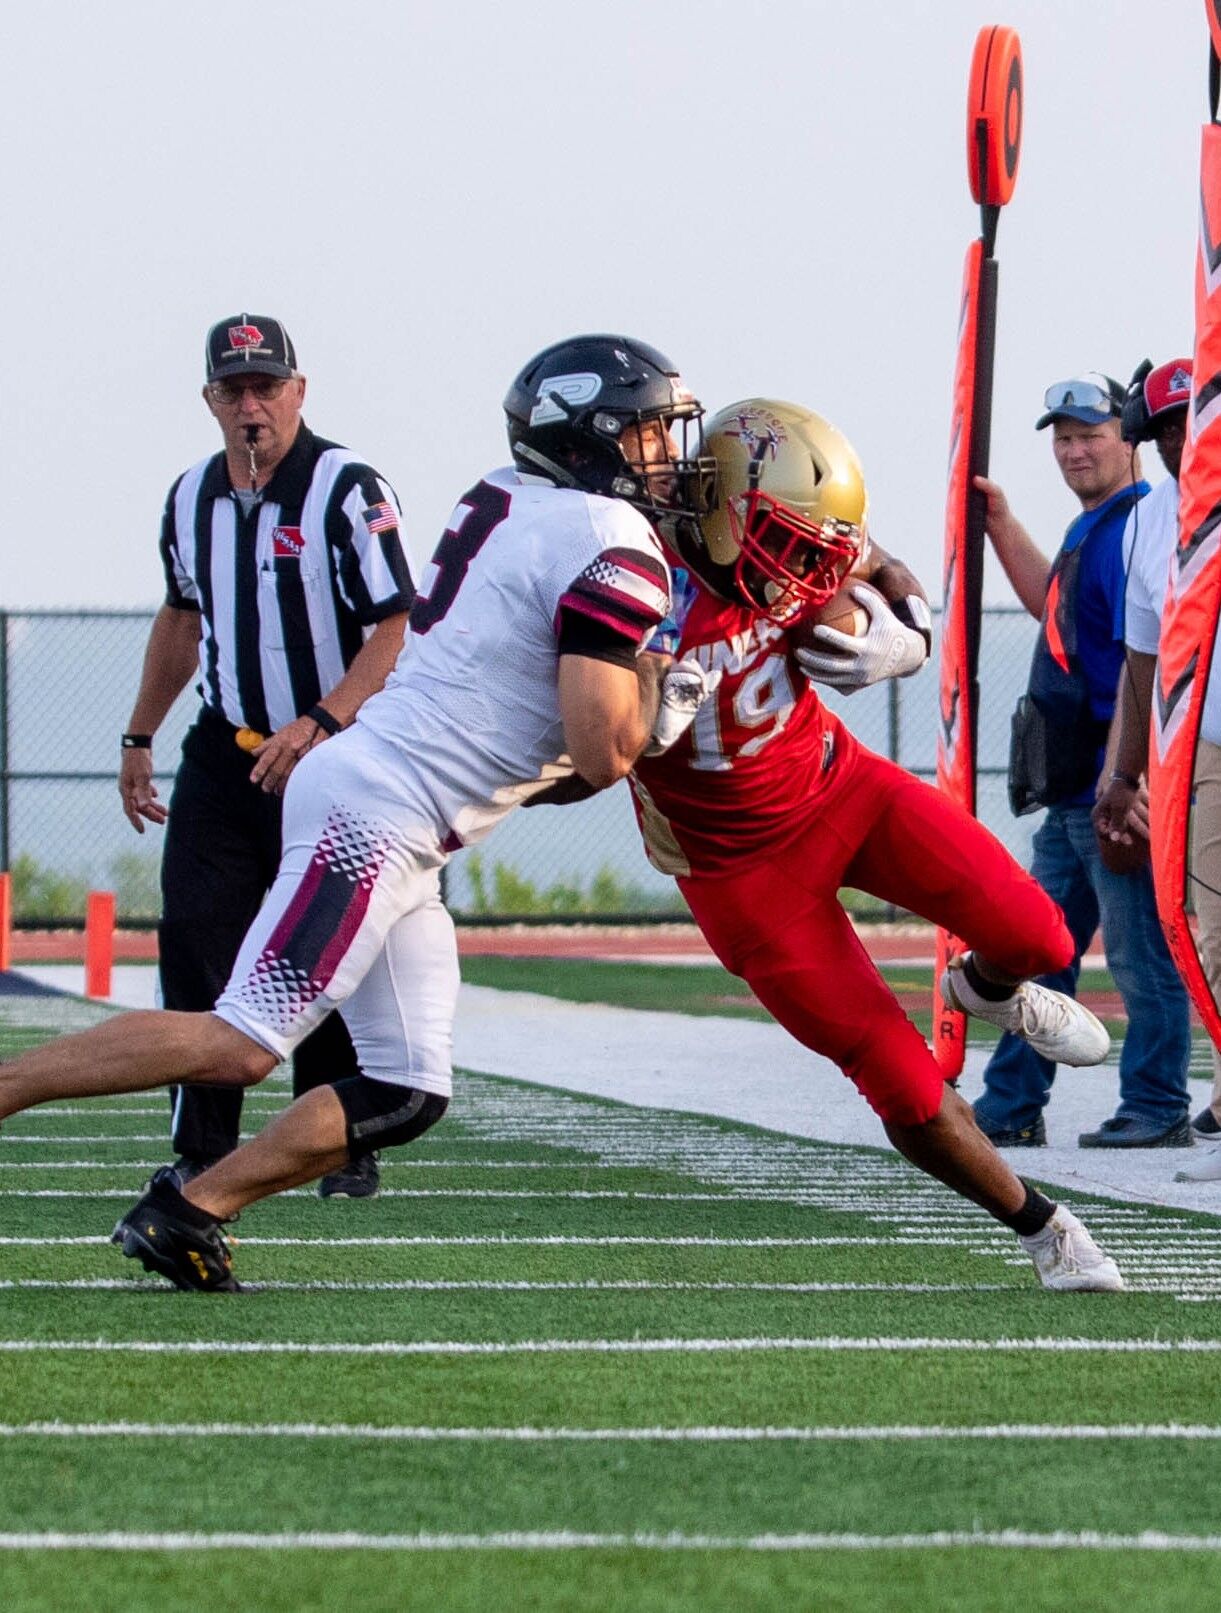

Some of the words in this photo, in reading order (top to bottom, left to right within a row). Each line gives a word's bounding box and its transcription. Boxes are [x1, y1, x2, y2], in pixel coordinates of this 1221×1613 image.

[530, 372, 602, 427] P
[409, 479, 512, 636] 3
[688, 652, 796, 771] 19
